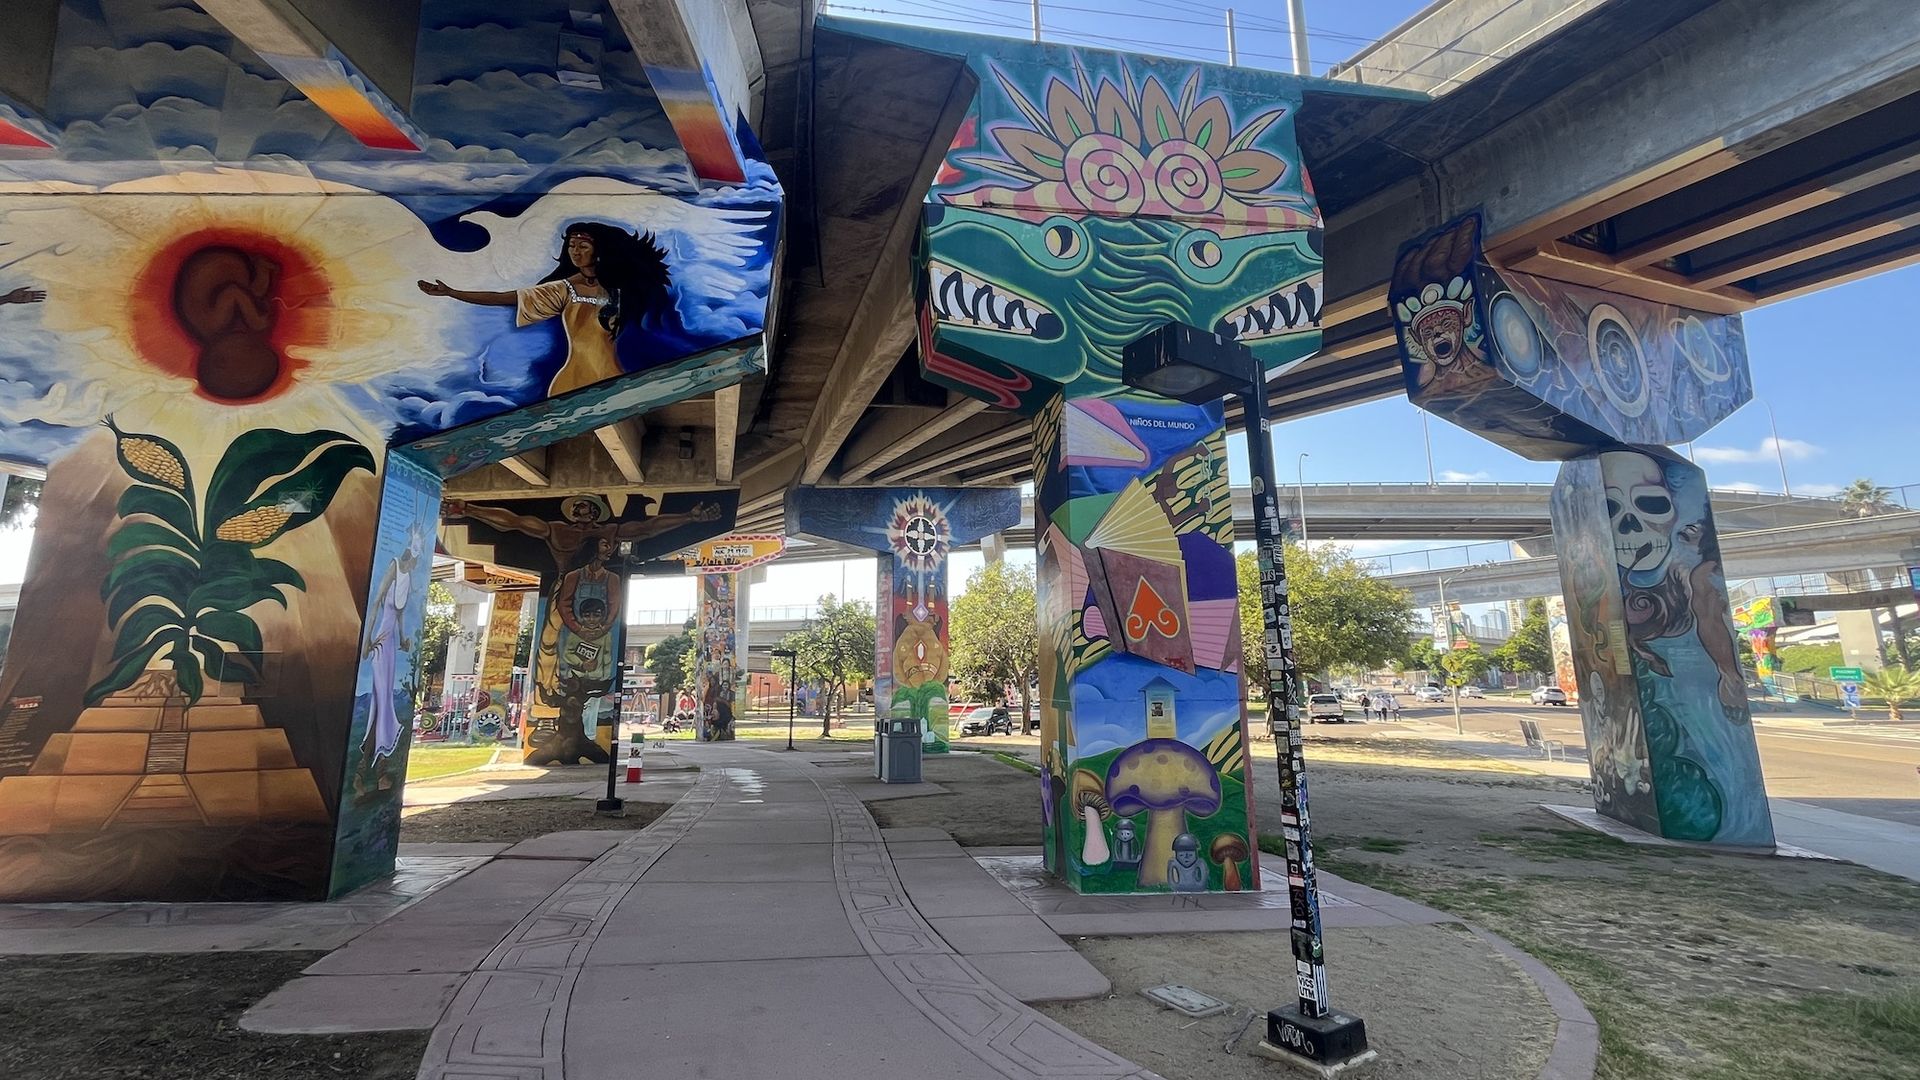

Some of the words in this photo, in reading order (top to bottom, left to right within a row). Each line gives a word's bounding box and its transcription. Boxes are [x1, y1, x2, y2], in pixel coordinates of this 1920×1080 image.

[1130, 417, 1152, 427] NIÑOS
[1153, 420, 1167, 429] DEL
[1167, 421, 1195, 430] MUNDO
